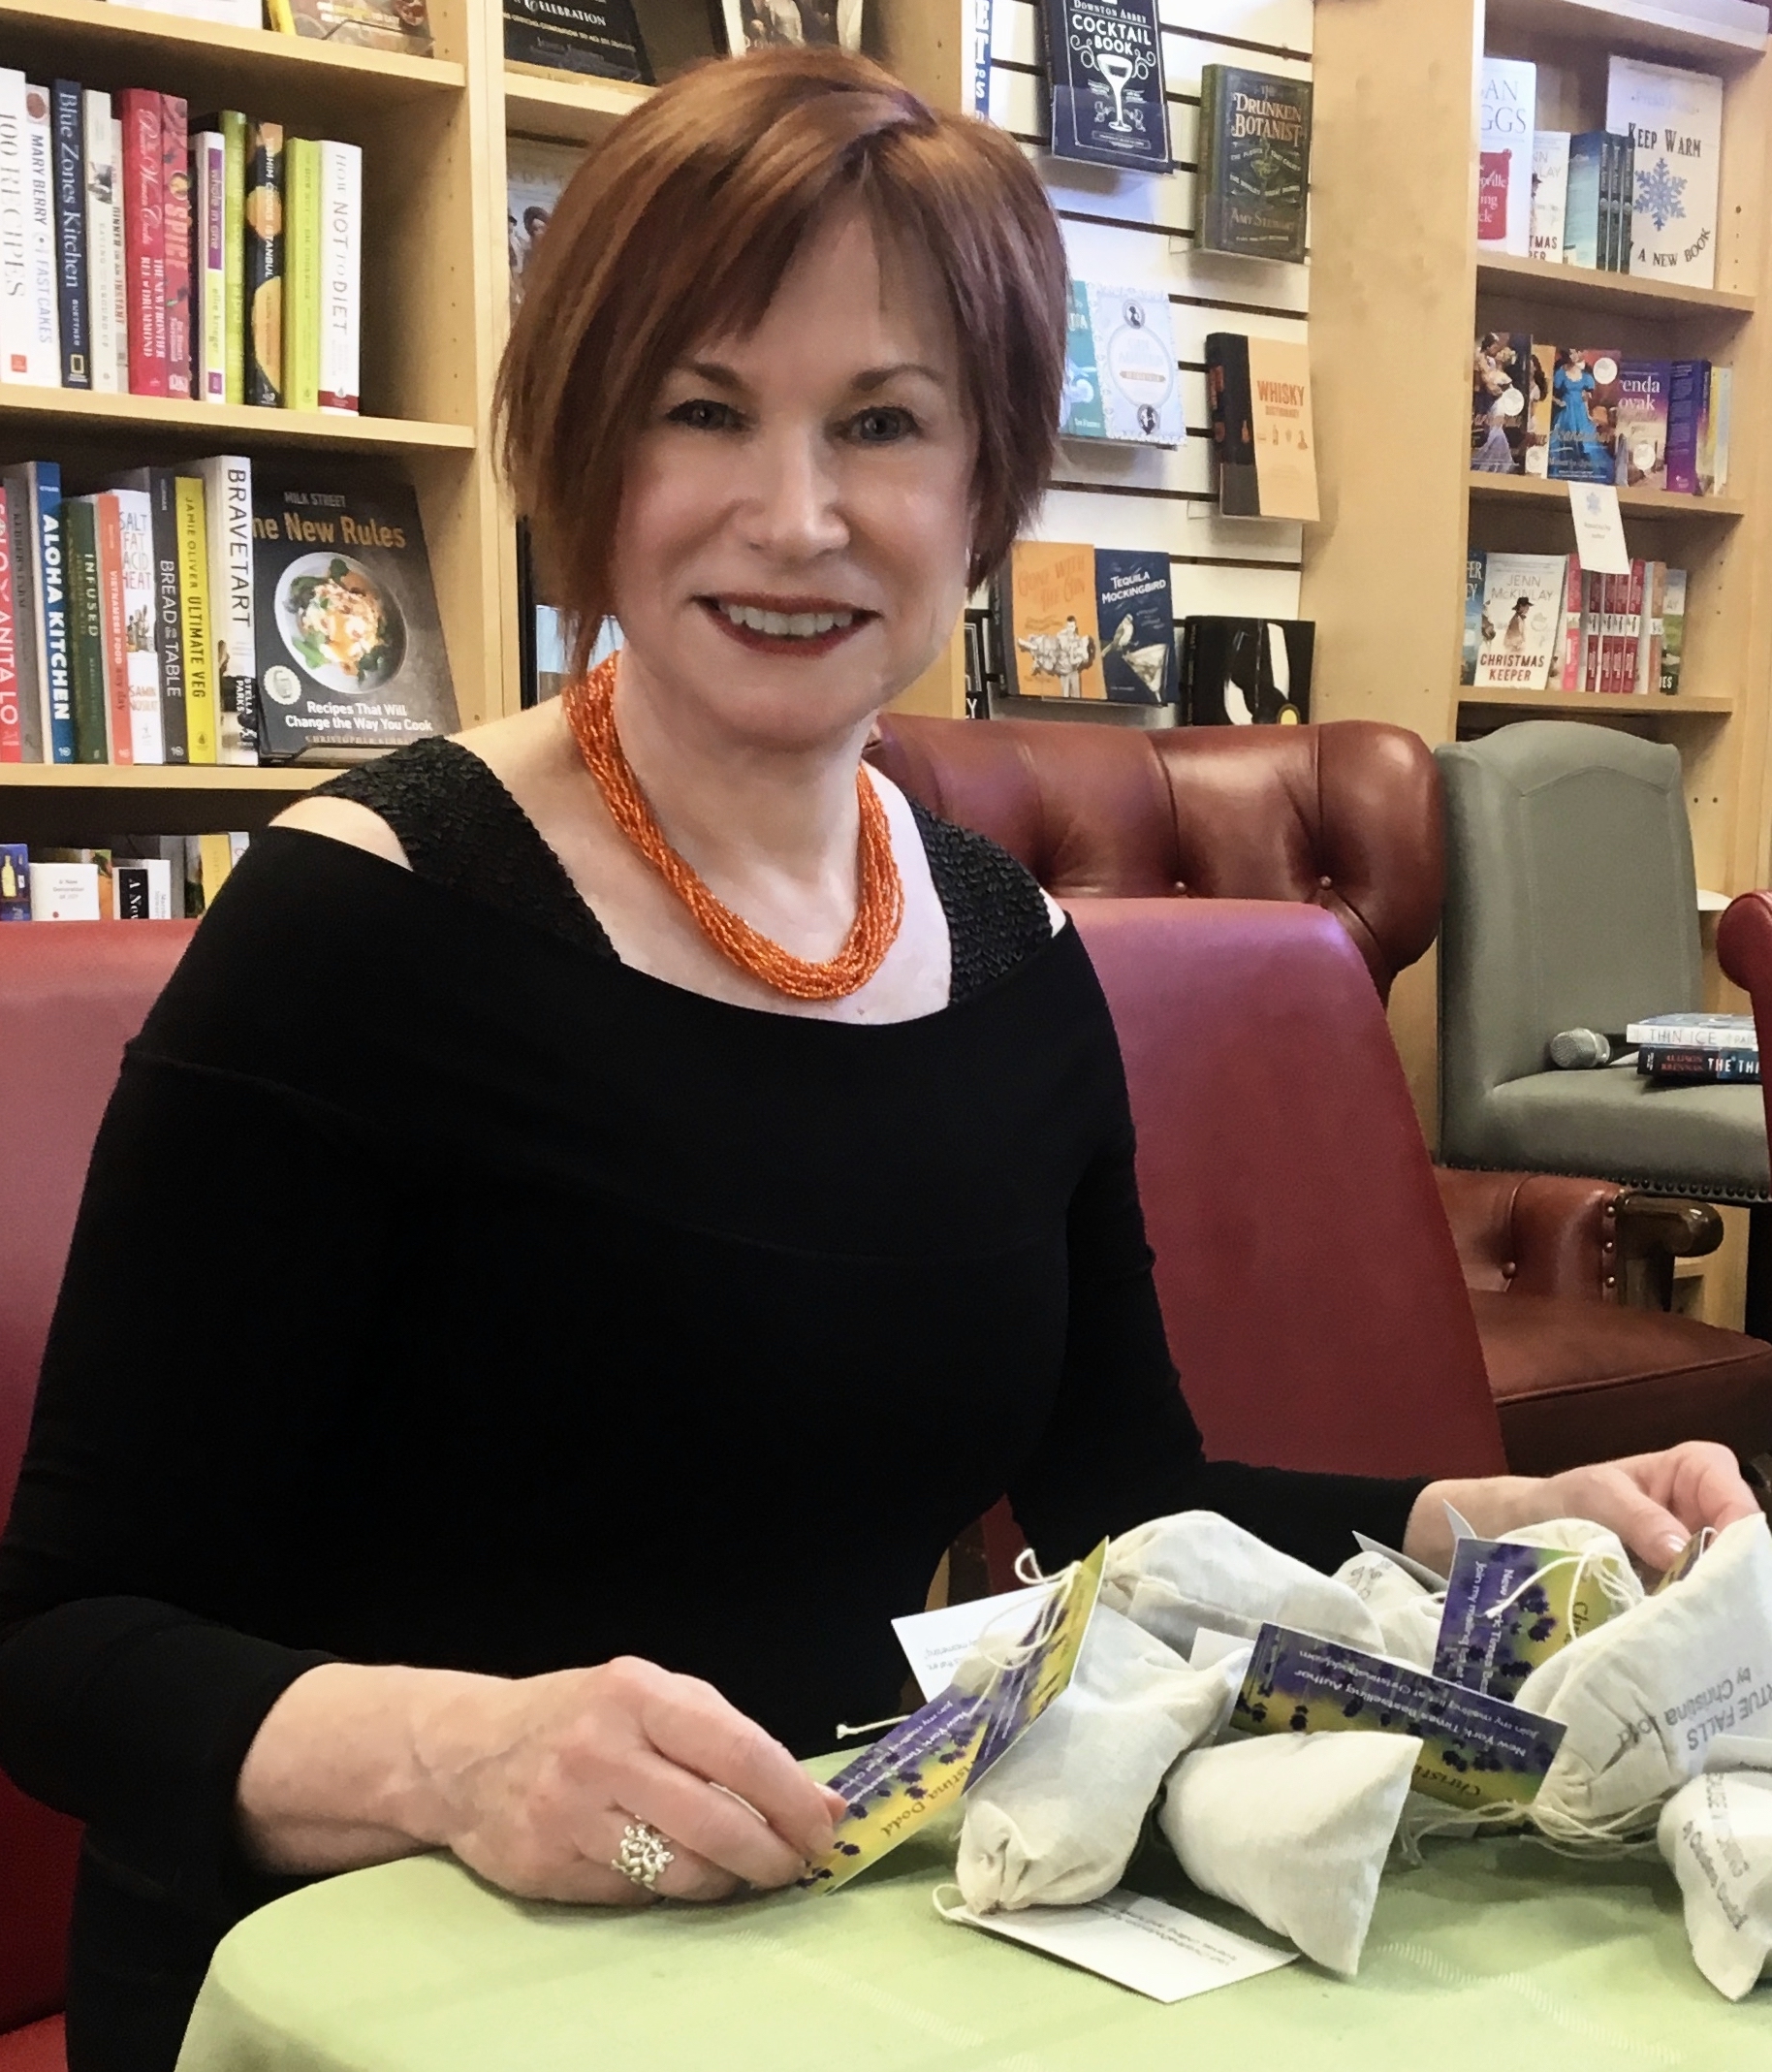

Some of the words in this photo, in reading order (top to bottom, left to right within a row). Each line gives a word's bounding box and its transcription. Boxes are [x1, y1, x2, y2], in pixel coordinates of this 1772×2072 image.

[1073, 1, 1117, 16] DOWNTON
[1072, 15, 1152, 46] COCKTAIL
[1094, 34, 1133, 55] BOOK
[1231, 92, 1301, 122] DRUNKEN
[1482, 79, 1519, 102] AN
[59, 92, 79, 138] Blue
[1231, 112, 1302, 146] BOTANIST
[31, 135, 45, 177] MARY
[1629, 122, 1658, 149] KEEP
[1664, 128, 1701, 157] WARM
[61, 143, 79, 204] Zones
[210, 169, 221, 206] whole
[33, 179, 47, 225] BERRY
[1, 168, 26, 297] RECIPES
[165, 204, 188, 271] SPICE
[332, 201, 348, 250] NOT
[62, 210, 81, 287] Kitchen
[1653, 252, 1678, 268] NEW
[1684, 228, 1712, 263] BOOK
[37, 260, 50, 297] FAST
[39, 298, 51, 344] CAKES
[142, 288, 153, 357] DRUMMOND
[332, 280, 348, 335] DIET
[1256, 380, 1305, 406] WHISKY
[185, 497, 197, 535] JAMIE
[284, 512, 334, 543] New
[342, 517, 407, 549] Rules
[43, 514, 67, 604] ALOHA
[187, 541, 199, 589] OLIVER
[228, 468, 250, 627] BRAVETART
[83, 554, 98, 637] INFUSED
[160, 560, 178, 623] BREAD
[1101, 579, 1167, 604] MOCKINGBIRD
[1111, 571, 1151, 590] TEQUILA
[1506, 574, 1541, 588] JENN
[188, 596, 205, 664] ULTIMATE
[46, 611, 70, 719] KITCHEN
[165, 641, 181, 697] TABLE
[1480, 653, 1545, 668] CHRISTMAS
[1488, 669, 1532, 683] KEEPER
[191, 672, 206, 698] VEG
[244, 678, 253, 715] STELLA
[3, 690, 18, 725] LO
[285, 716, 331, 732] Change
[332, 716, 354, 730] the
[354, 717, 379, 732] Way
[380, 717, 402, 732] You
[403, 717, 433, 732] Cook
[307, 700, 354, 716] Recipes
[355, 702, 382, 717] That
[383, 703, 408, 717] Will
[1650, 1028, 1683, 1043] THIN
[1690, 1030, 1718, 1044] ICE
[1708, 1058, 1731, 1076] THE
[1500, 1568, 1514, 1596] New
[1485, 1631, 1502, 1667] Times
[1294, 1670, 1343, 1691] Author
[1736, 1666, 1752, 1685] by
[1663, 1678, 1734, 1727] Christina
[1464, 1728, 1494, 1745] York
[1687, 1705, 1735, 1751] FALLS
[1497, 1740, 1527, 1756] New
[880, 1801, 927, 1836] Dodd
